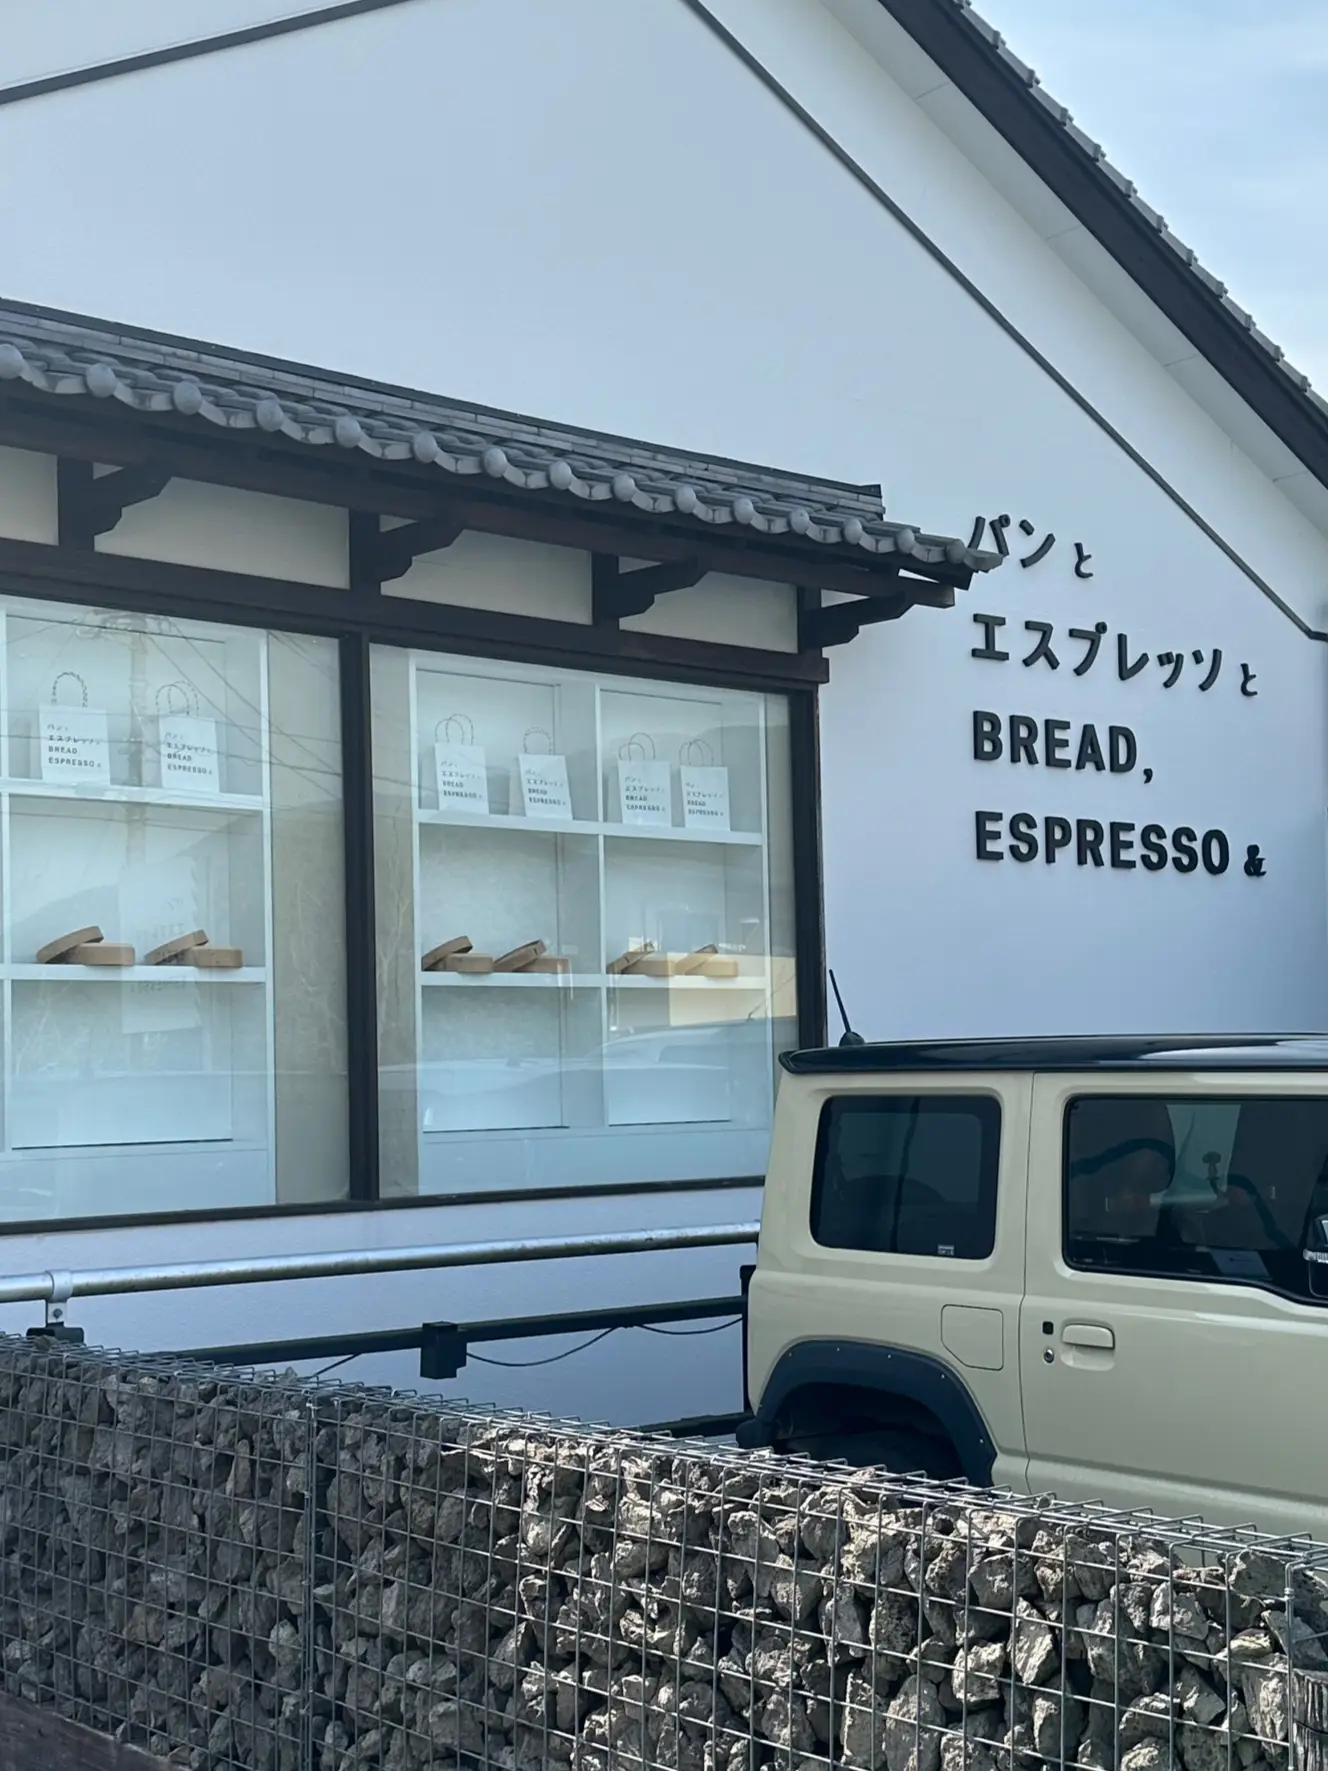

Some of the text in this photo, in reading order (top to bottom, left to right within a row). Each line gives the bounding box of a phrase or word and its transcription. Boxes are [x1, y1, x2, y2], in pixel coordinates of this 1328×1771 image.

[967, 513, 1094, 579] パンと
[970, 612, 1258, 698] エスプレッソと
[972, 709, 1154, 784] BREAD,
[974, 809, 1267, 878] ESPRESSO &
